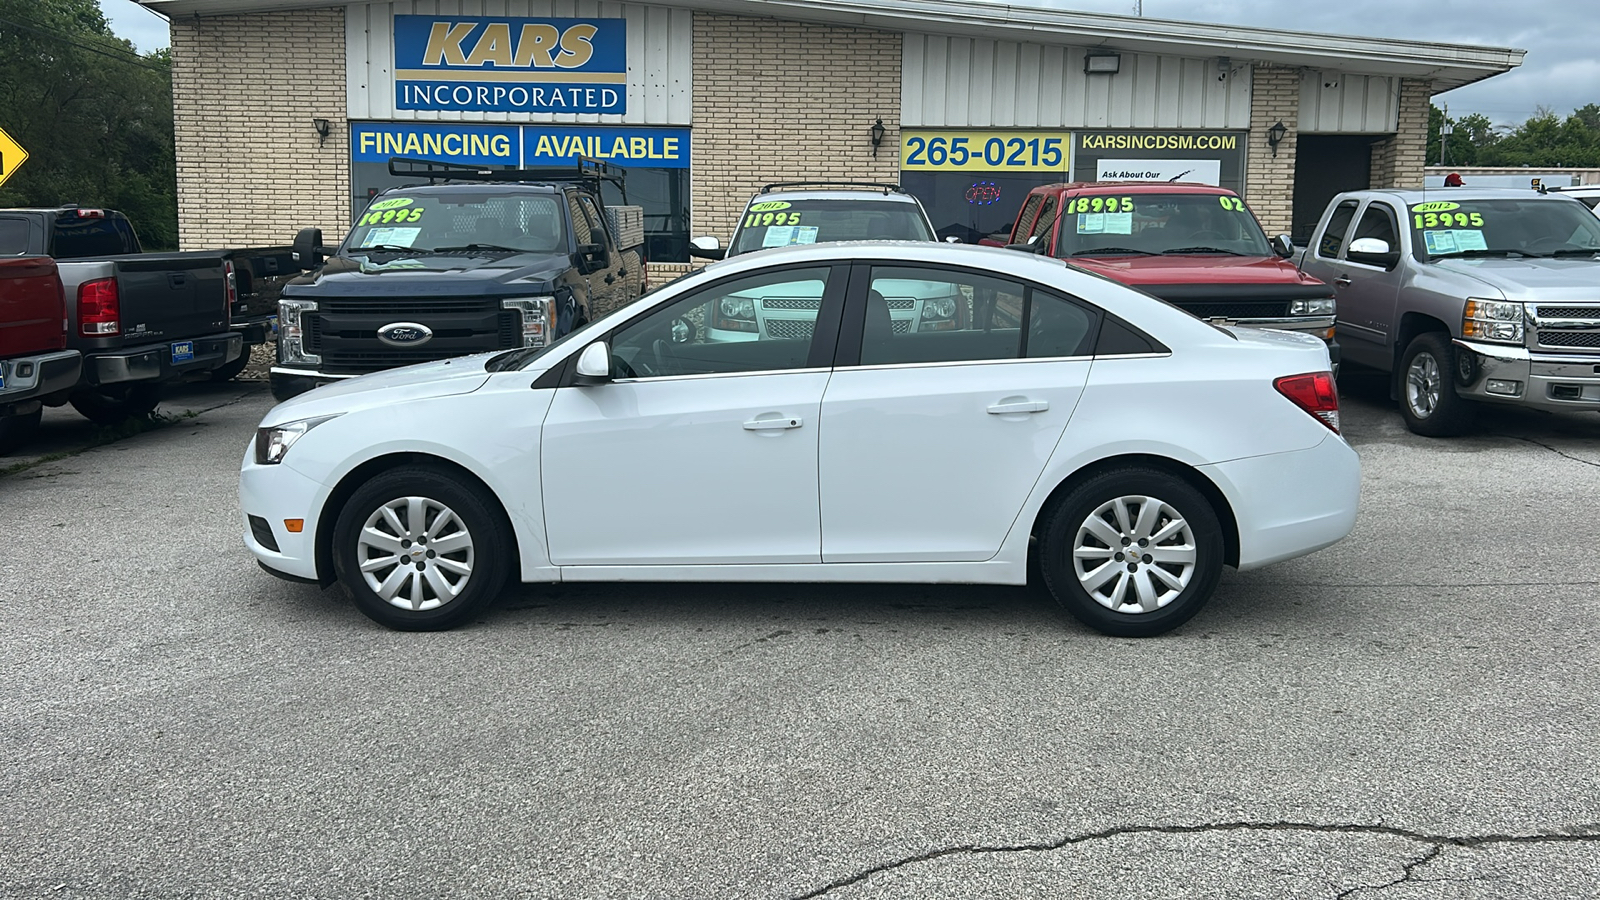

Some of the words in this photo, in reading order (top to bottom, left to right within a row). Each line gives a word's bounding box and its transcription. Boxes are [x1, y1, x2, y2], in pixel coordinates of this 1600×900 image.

[422, 22, 599, 68] KARS
[404, 84, 618, 108] INCORPORATED
[360, 132, 510, 157] FINANCING
[534, 135, 679, 159] AVAILABLE
[1082, 135, 1236, 149] KARSINCDSM.COM
[906, 137, 1062, 166] 265-0215
[1145, 171, 1160, 179] Our
[965, 186, 1001, 200] OPEN
[1067, 197, 1134, 214] 18995
[1219, 196, 1245, 212] 02
[1422, 202, 1451, 211] 2012
[358, 208, 424, 226] 14995
[744, 212, 801, 228] 11995
[1414, 212, 1485, 229] 13995
[391, 328, 417, 340] Ford
